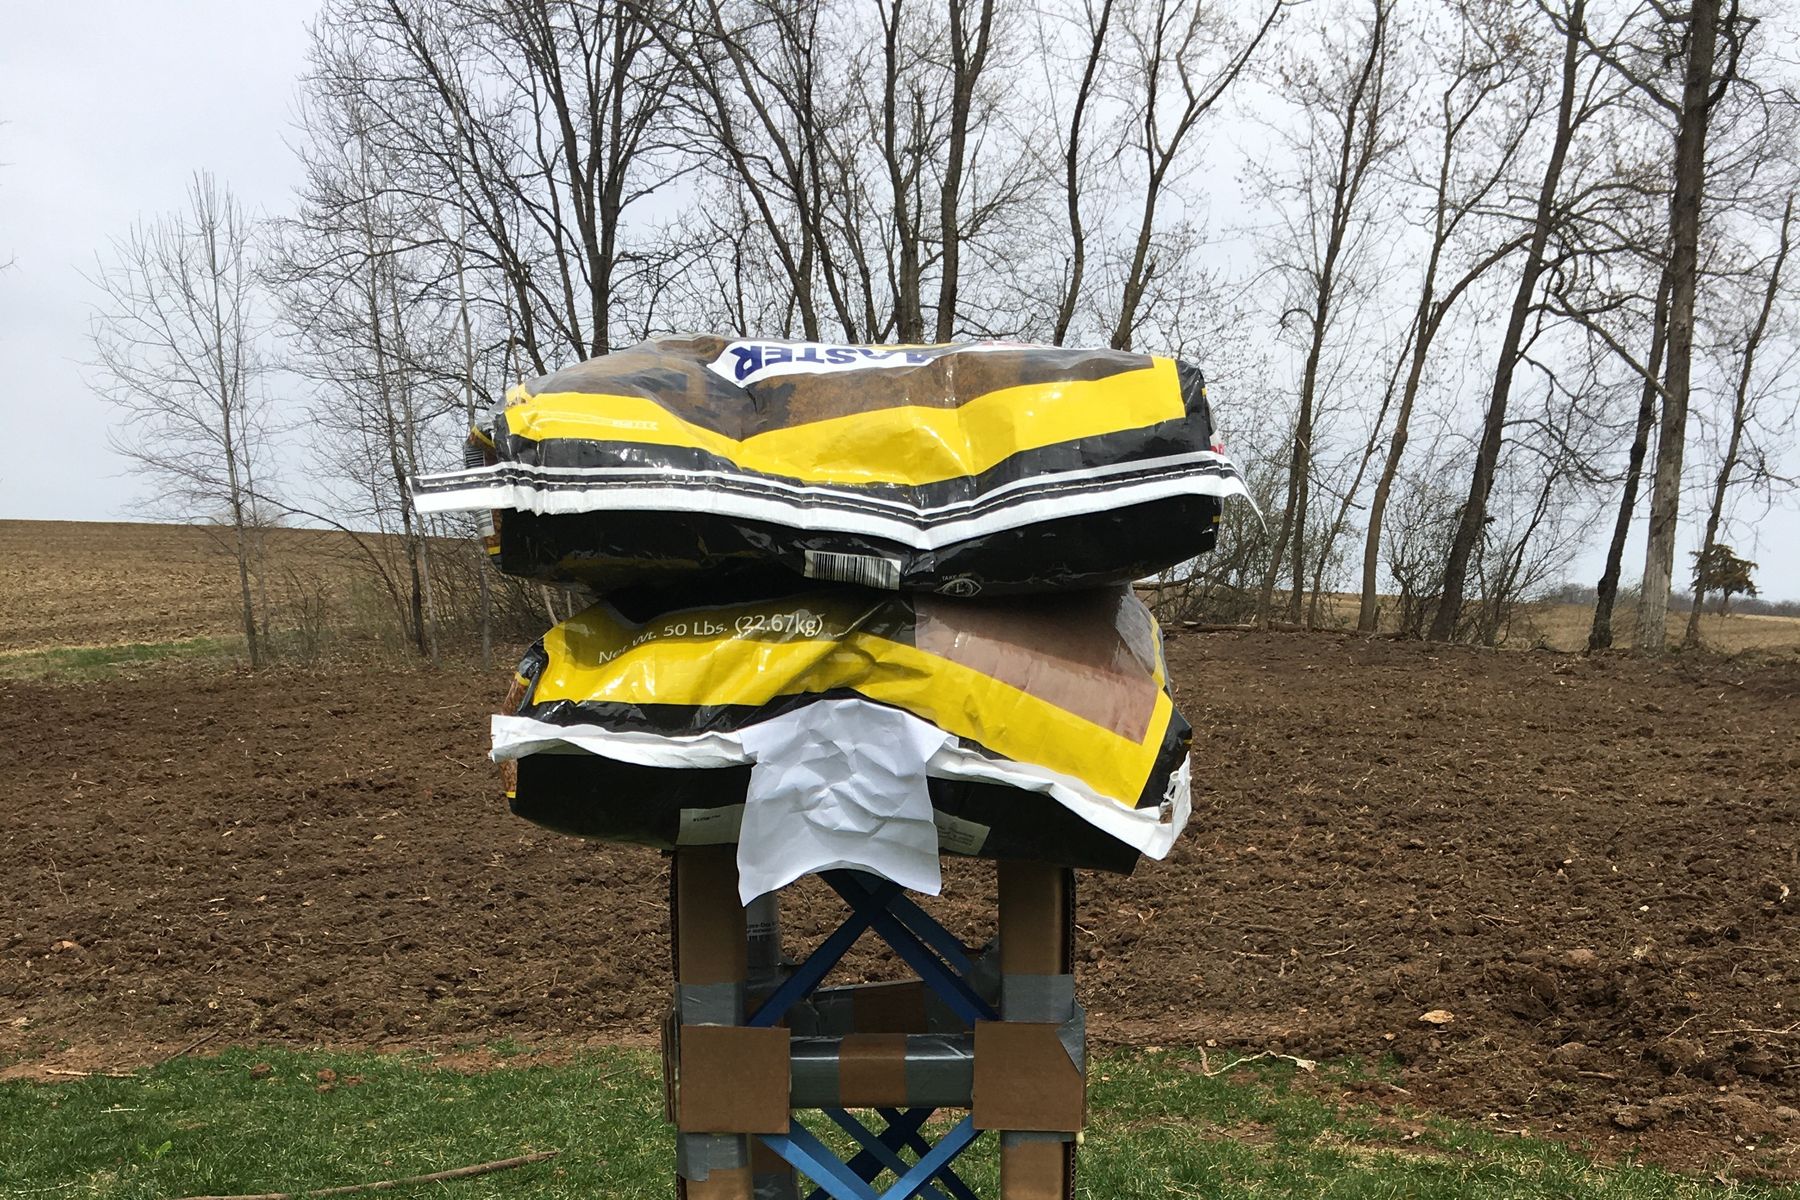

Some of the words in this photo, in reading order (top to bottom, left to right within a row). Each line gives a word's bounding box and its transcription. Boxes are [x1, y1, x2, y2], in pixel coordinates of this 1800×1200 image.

[663, 623, 688, 637] 50
[694, 621, 728, 636] Lbs.
[735, 613, 823, 637] (22.67kg)
